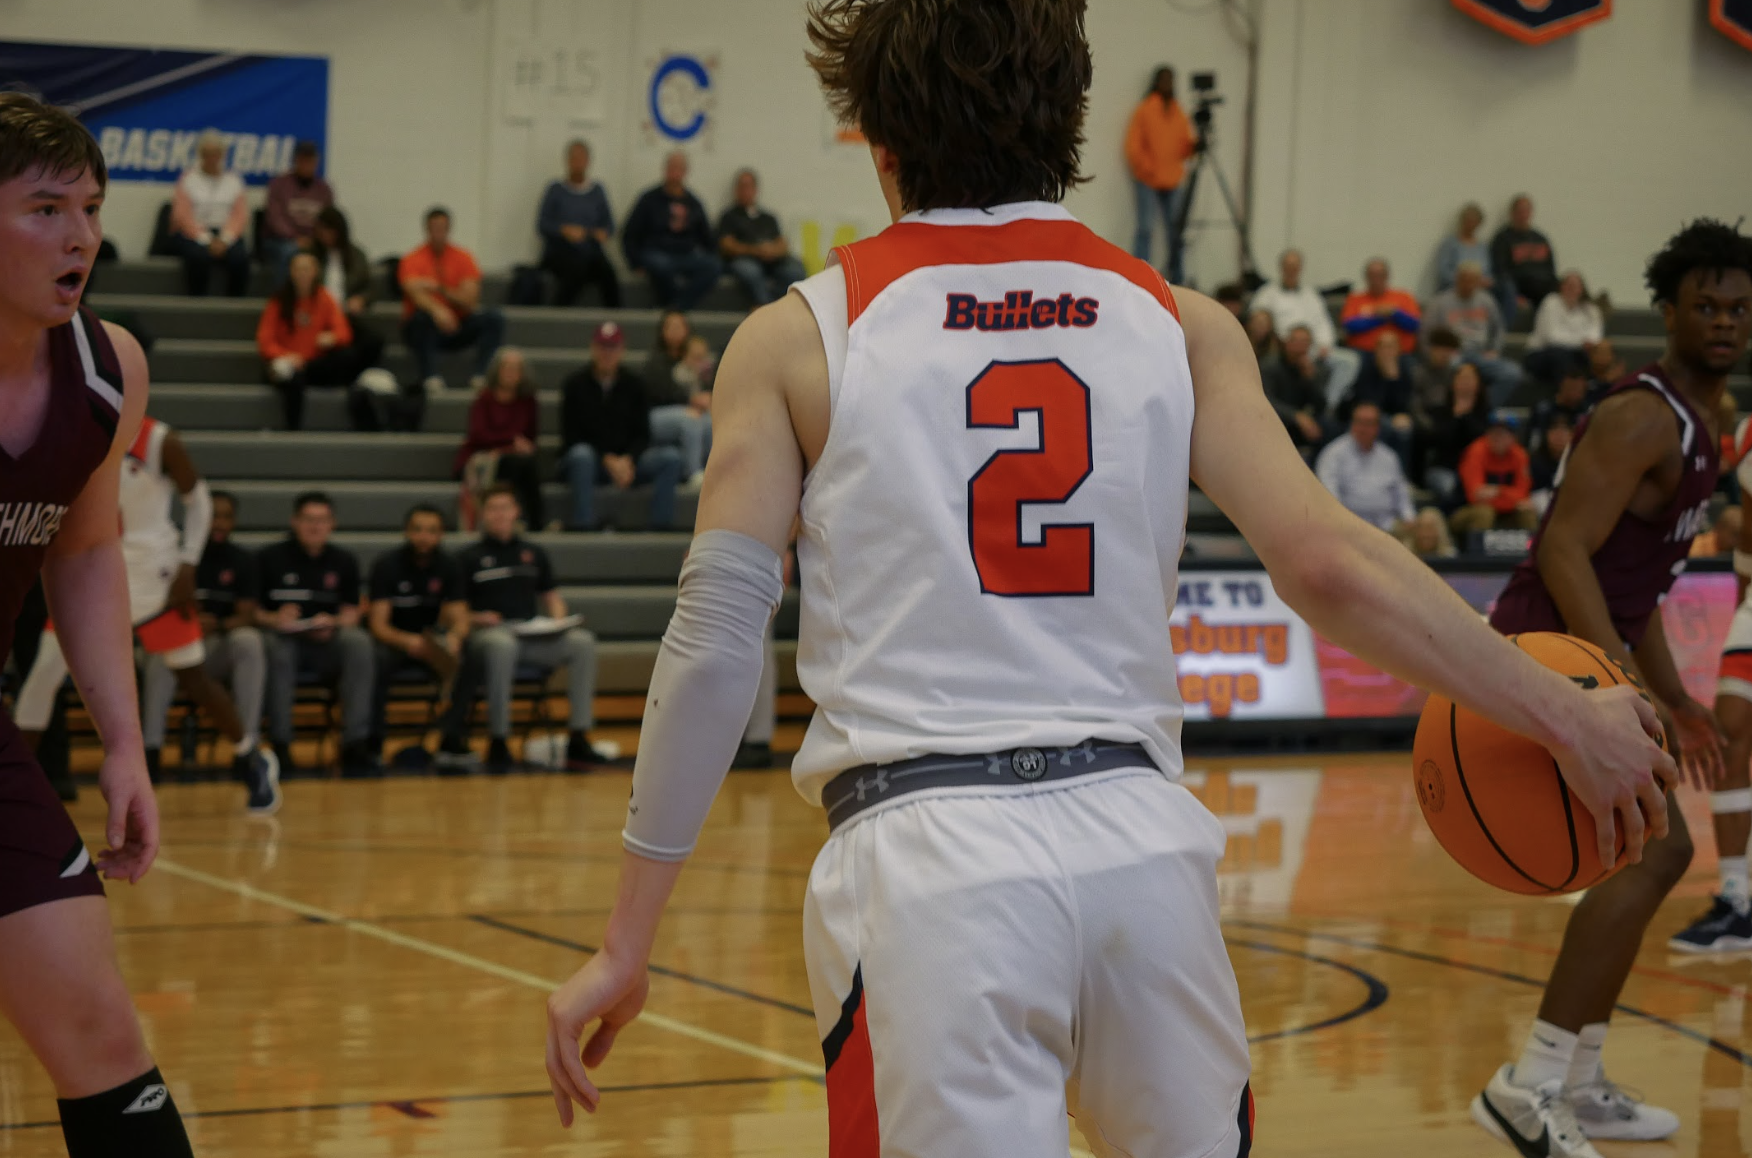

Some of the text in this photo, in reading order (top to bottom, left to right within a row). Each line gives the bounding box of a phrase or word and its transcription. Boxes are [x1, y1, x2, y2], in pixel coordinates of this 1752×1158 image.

[943, 290, 1099, 331] Bullets
[965, 357, 1095, 597] 2
[1221, 581, 1264, 607] TO
